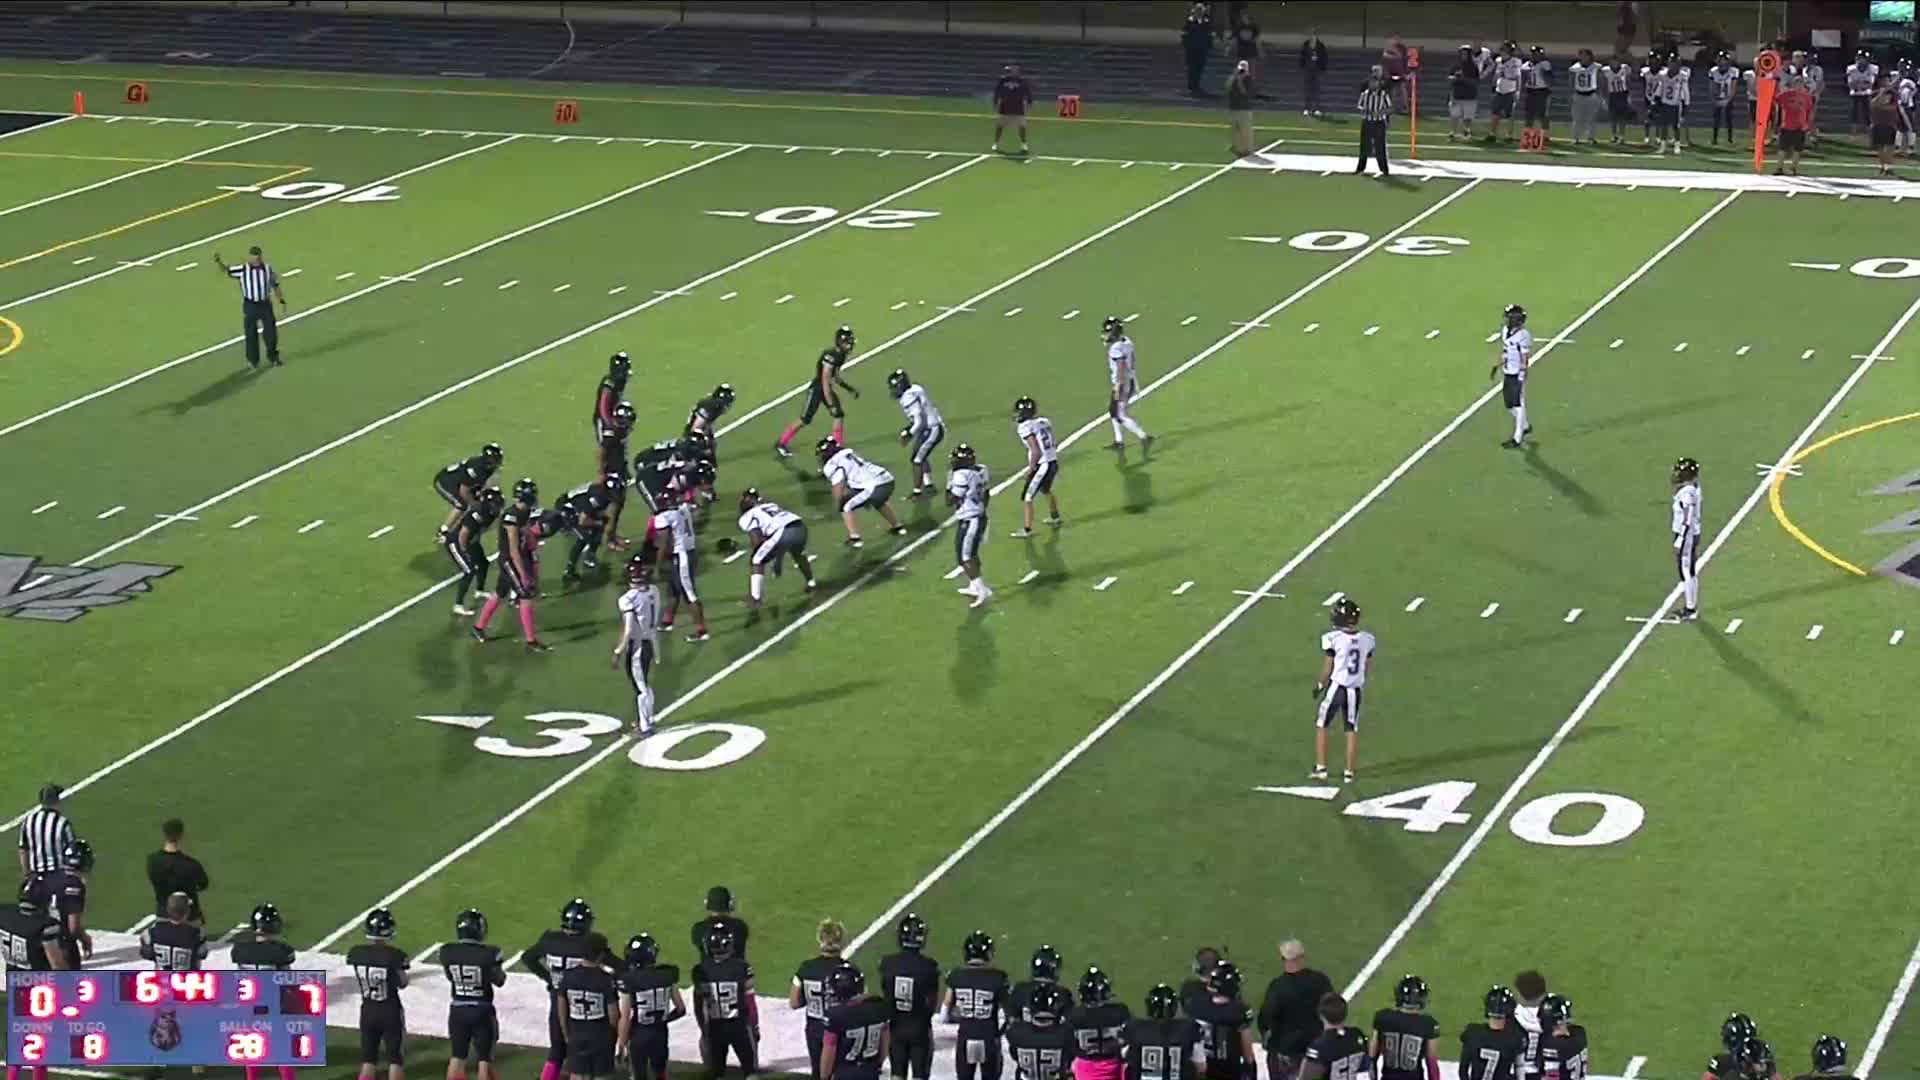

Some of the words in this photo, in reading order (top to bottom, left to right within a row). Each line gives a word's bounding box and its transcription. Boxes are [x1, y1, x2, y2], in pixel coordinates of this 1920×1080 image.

[1058, 97, 1079, 118] 20
[754, 206, 941, 229] 20
[1288, 230, 1470, 255] 30
[1347, 648, 1361, 676] 3
[473, 712, 767, 770] 30
[1342, 780, 1645, 846] 40
[894, 976, 914, 1012] 9
